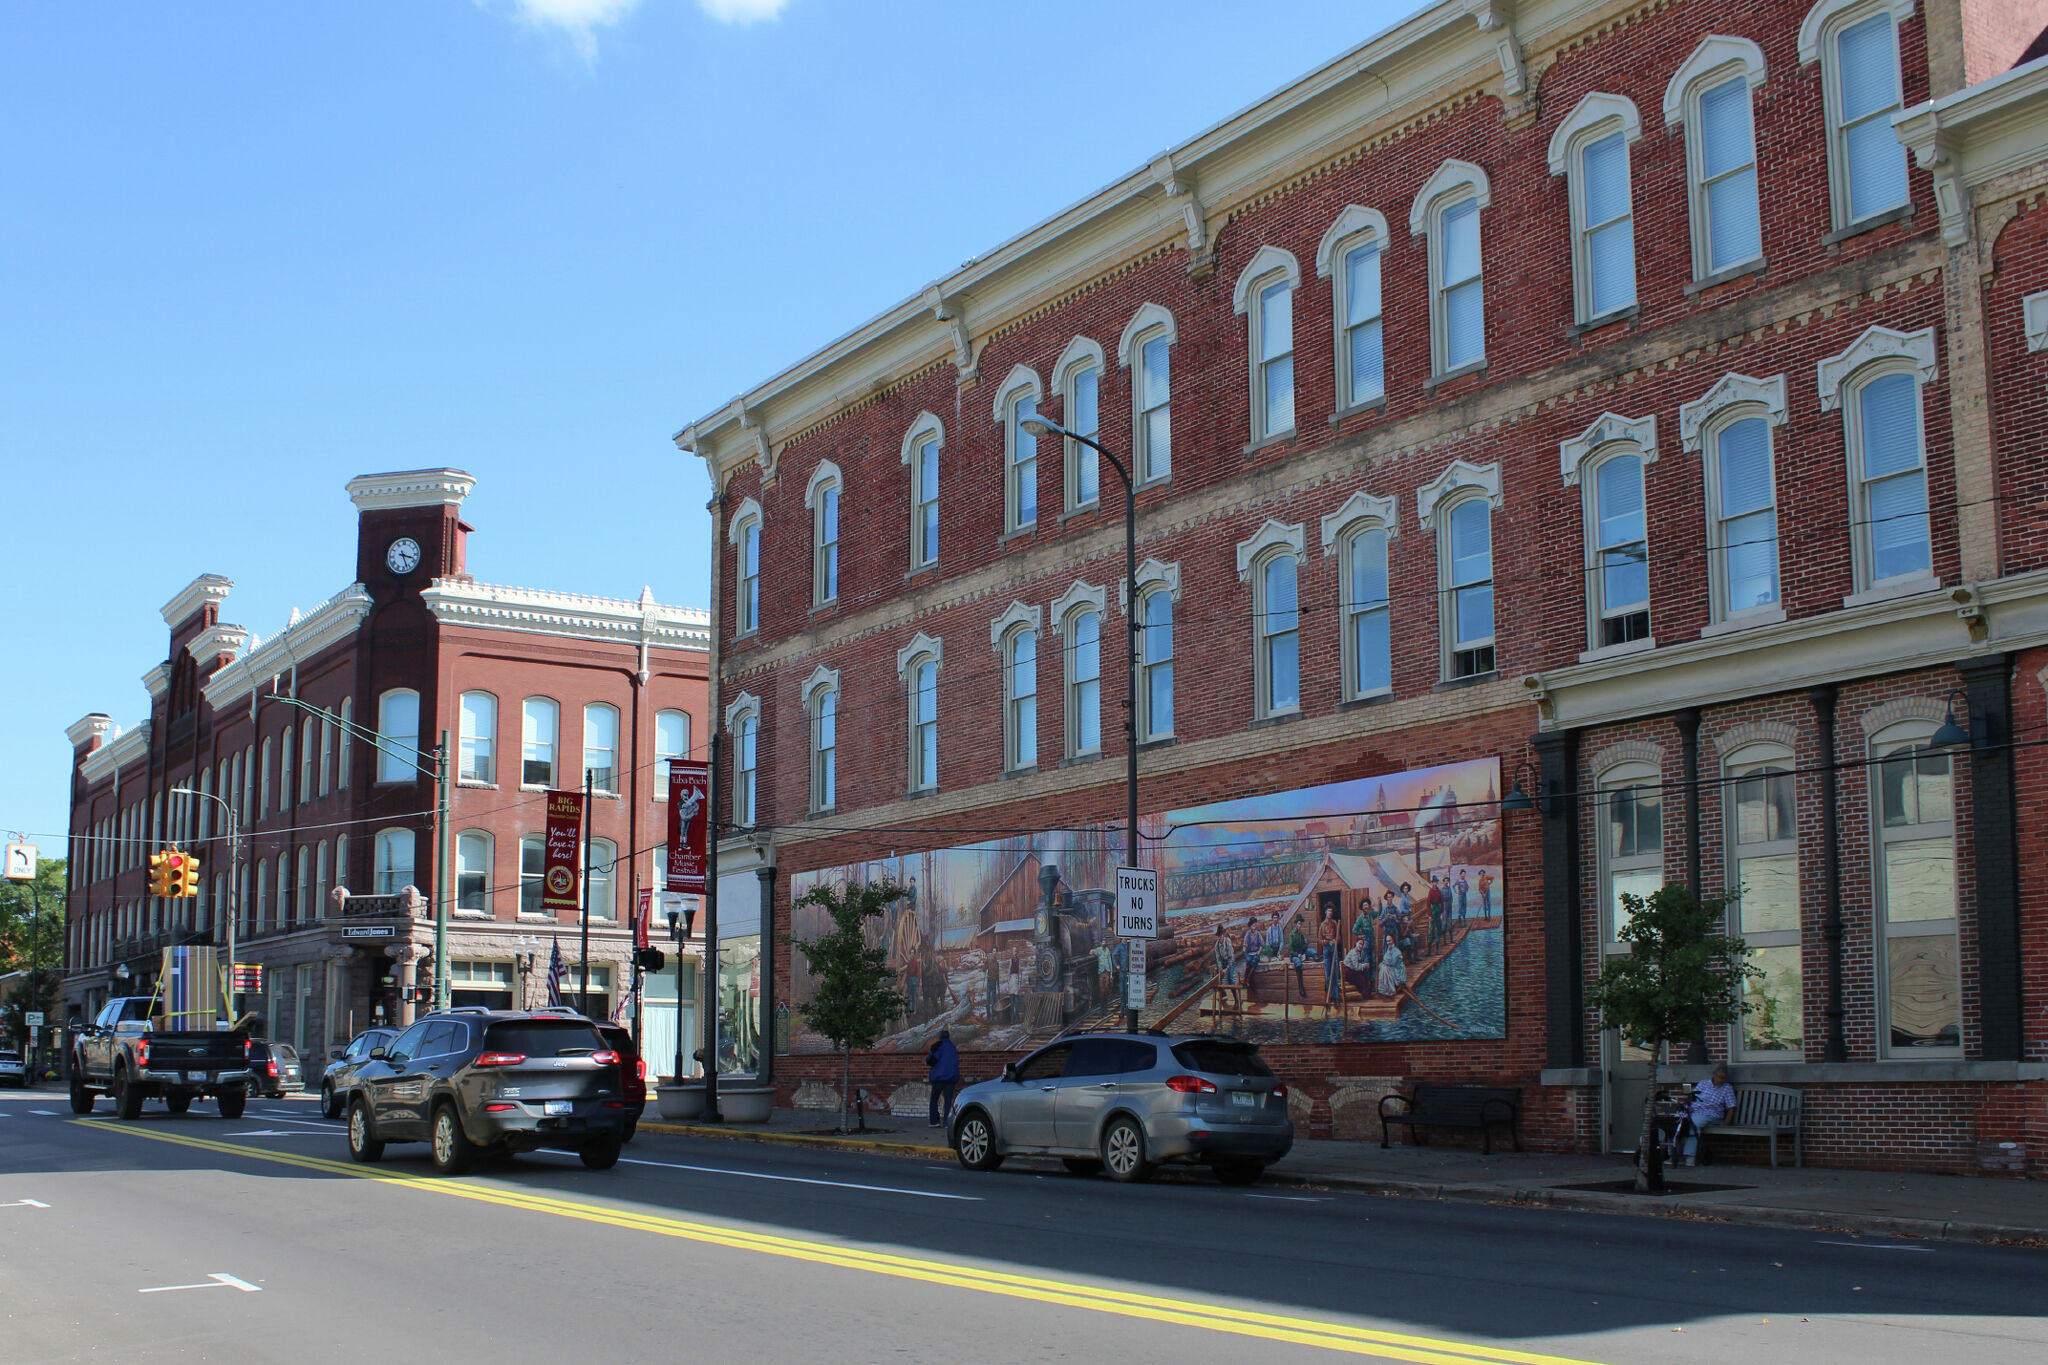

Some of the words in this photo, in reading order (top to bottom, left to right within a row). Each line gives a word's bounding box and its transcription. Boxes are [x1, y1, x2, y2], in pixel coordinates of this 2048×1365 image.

[689, 776, 707, 785] Bach
[558, 796, 573, 805] BIG
[549, 803, 580, 813] RAPIDS
[551, 827, 576, 838] You'll
[553, 849, 573, 860] here!
[669, 851, 701, 860] Chamber
[13, 866, 33, 874] ONLY
[672, 866, 698, 874] Festival
[1119, 876, 1155, 891] TRUCKS
[1131, 897, 1143, 910] NO
[1122, 916, 1153, 930] TURNS
